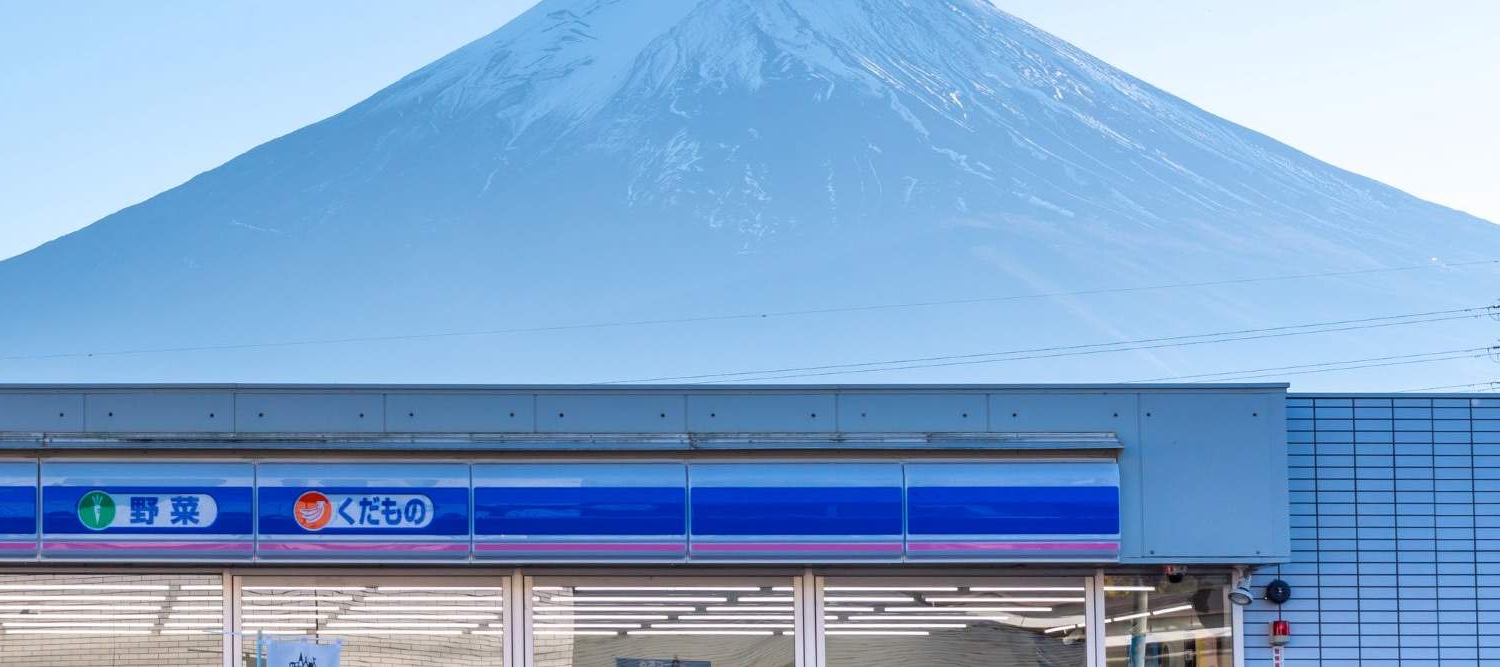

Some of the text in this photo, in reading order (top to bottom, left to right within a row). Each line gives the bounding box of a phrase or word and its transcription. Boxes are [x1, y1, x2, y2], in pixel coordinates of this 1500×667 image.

[129, 496, 201, 526] 野菜
[336, 497, 427, 526] くだもの
